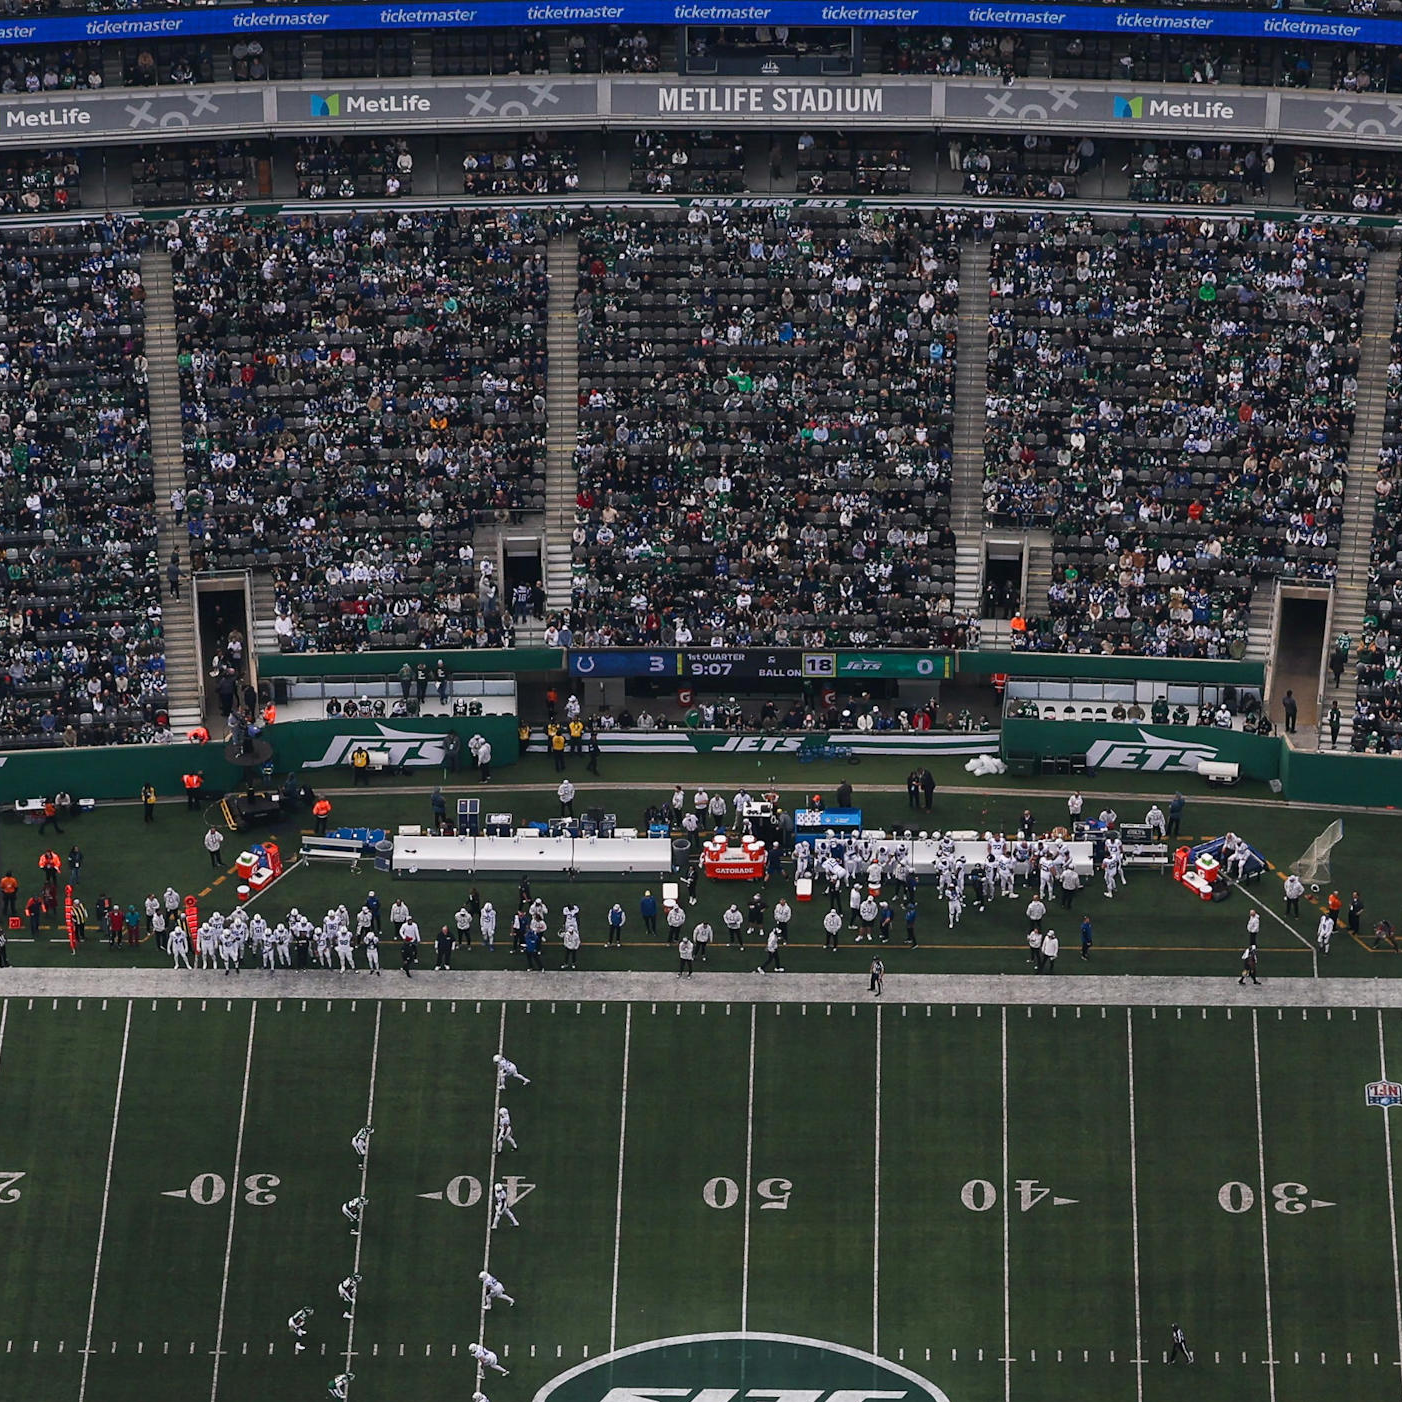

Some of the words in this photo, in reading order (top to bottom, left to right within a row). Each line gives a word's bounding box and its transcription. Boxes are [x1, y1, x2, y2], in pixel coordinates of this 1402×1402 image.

[233, 11, 330, 27] ticketmaster
[380, 8, 477, 23] ticketmaster
[527, 5, 624, 20] ticketmaster
[675, 4, 770, 20] ticketmaster
[822, 6, 919, 21] ticketmaster
[969, 8, 1066, 24] ticketmaster
[87, 18, 183, 35] ticketmaster
[1117, 13, 1213, 30] ticketmaster
[1264, 17, 1360, 37] ticketmaster
[346, 94, 431, 114] MetLife
[658, 88, 764, 112] METLIFE
[772, 88, 883, 112] STADIUM
[1149, 99, 1234, 119] MetLife
[6, 107, 91, 128] MetLife
[689, 198, 738, 208] NEW
[741, 199, 796, 208] YORK
[799, 199, 849, 208] JETS
[183, 206, 247, 218] JETS
[1297, 213, 1362, 226] JETS
[649, 656, 665, 672] 3
[688, 653, 701, 662] 1st
[703, 653, 745, 662] QUARTER
[840, 659, 883, 670] JETS
[692, 663, 733, 676] 9:07
[758, 668, 786, 677] BALL
[787, 669, 802, 677] ON
[807, 657, 833, 672] 18
[916, 658, 934, 674] 0
[301, 722, 449, 768] JETS
[712, 736, 806, 752] JETS
[1086, 728, 1219, 771] JETS
[715, 867, 755, 875] GATORADE
[190, 1173, 280, 1205] 30
[447, 1175, 537, 1208] 40
[703, 1177, 792, 1209] 50
[961, 1180, 1050, 1211] 40
[1218, 1182, 1308, 1214] 30
